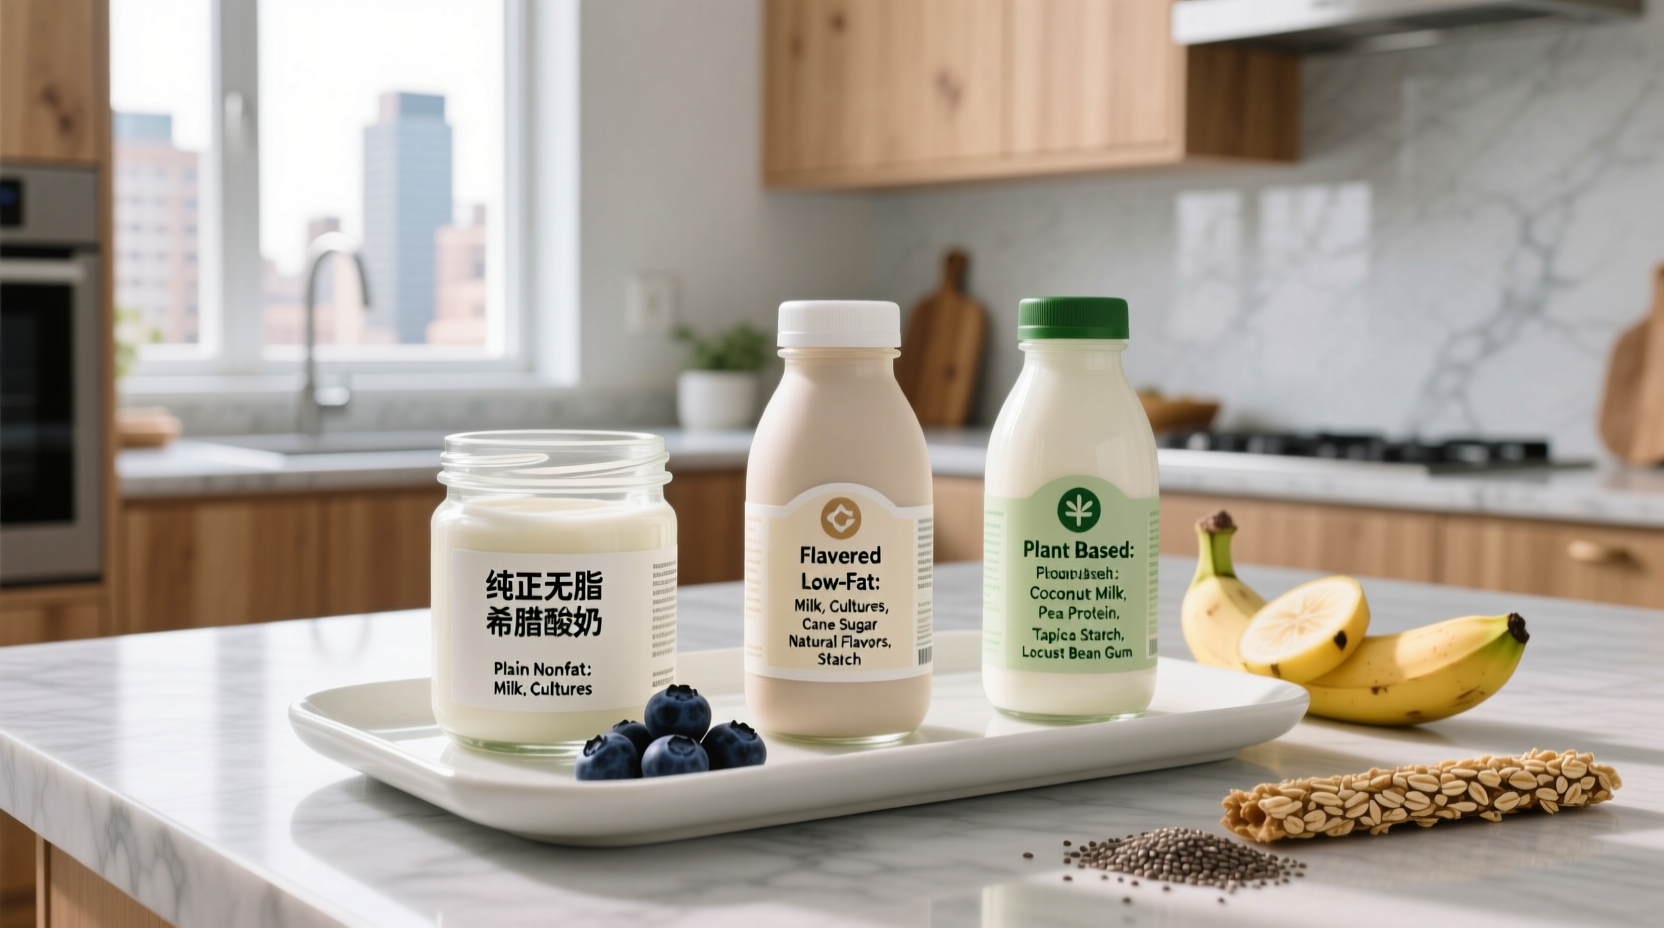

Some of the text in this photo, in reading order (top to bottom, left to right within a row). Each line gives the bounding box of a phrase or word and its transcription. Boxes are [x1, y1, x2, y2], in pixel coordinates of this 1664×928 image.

[800, 546, 881, 564] Flavered
[1024, 540, 1135, 559] Plant Based:
[486, 569, 603, 601] 纯正无脂
[801, 572, 880, 591] Low-Fat:
[1030, 585, 1127, 602] Coconut Milk,
[794, 598, 889, 615] Milk, Cultures,
[1038, 605, 1120, 620] Pea Protein,
[486, 606, 602, 637] 希腊酸奶
[802, 617, 878, 634] Cane Sugar
[789, 634, 892, 650] Natural Flavors,
[1080, 627, 1125, 642] Starch,
[817, 651, 862, 667] Starch
[1022, 645, 1133, 660] Locust Bean Gum
[494, 660, 592, 677] Plain Nonfat:
[494, 680, 593, 697] Milk, Cultures
